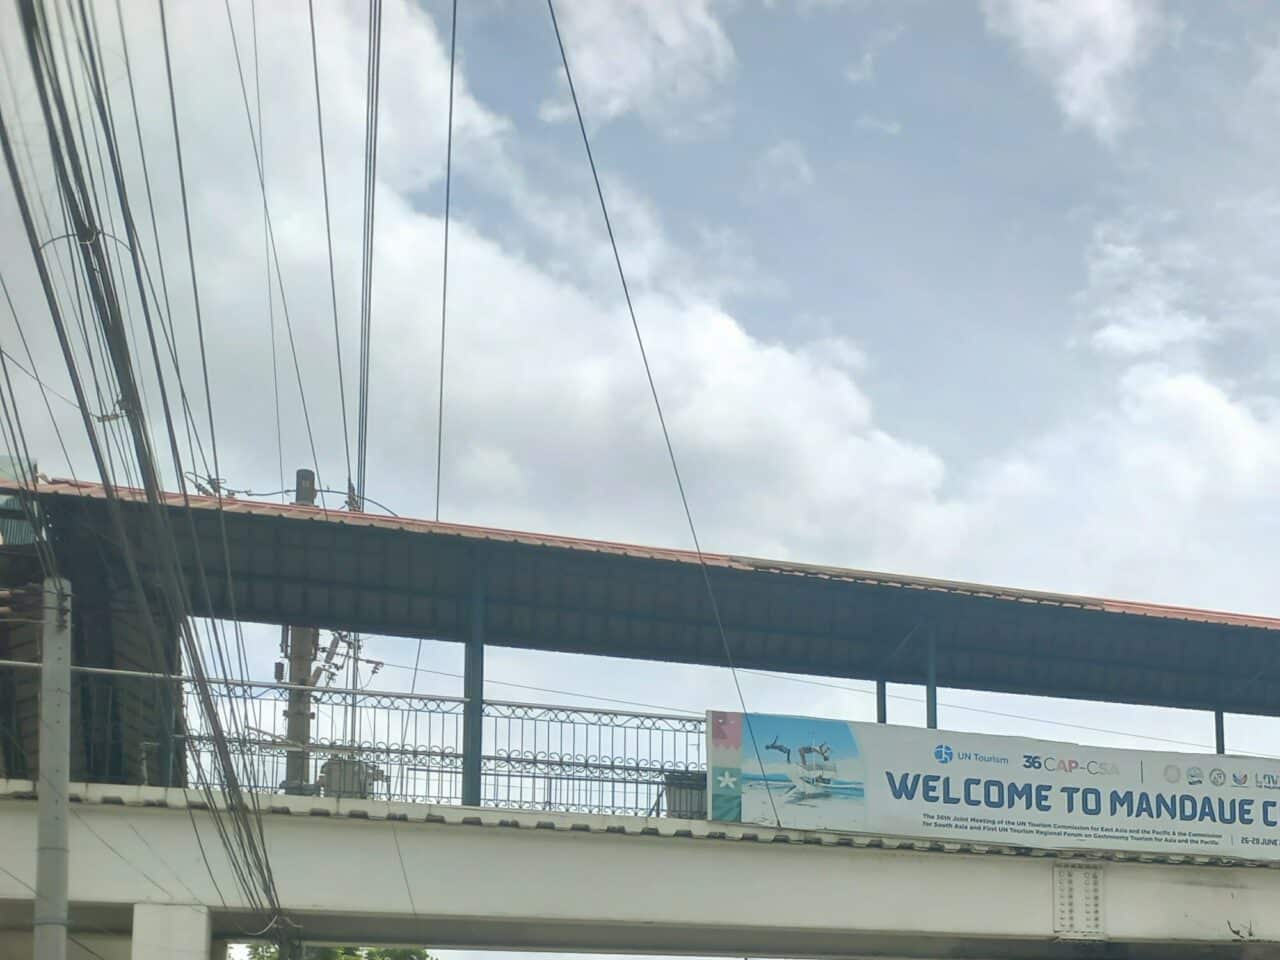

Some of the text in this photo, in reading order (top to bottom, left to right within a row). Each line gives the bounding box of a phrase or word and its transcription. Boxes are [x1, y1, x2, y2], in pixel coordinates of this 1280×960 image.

[957, 752, 971, 761] UN
[974, 753, 1009, 765] Tourism
[885, 771, 1053, 813] WELCOME
[1060, 786, 1101, 816] TO
[1110, 790, 1254, 825] MANDAUE
[1261, 838, 1278, 847] JUNE
